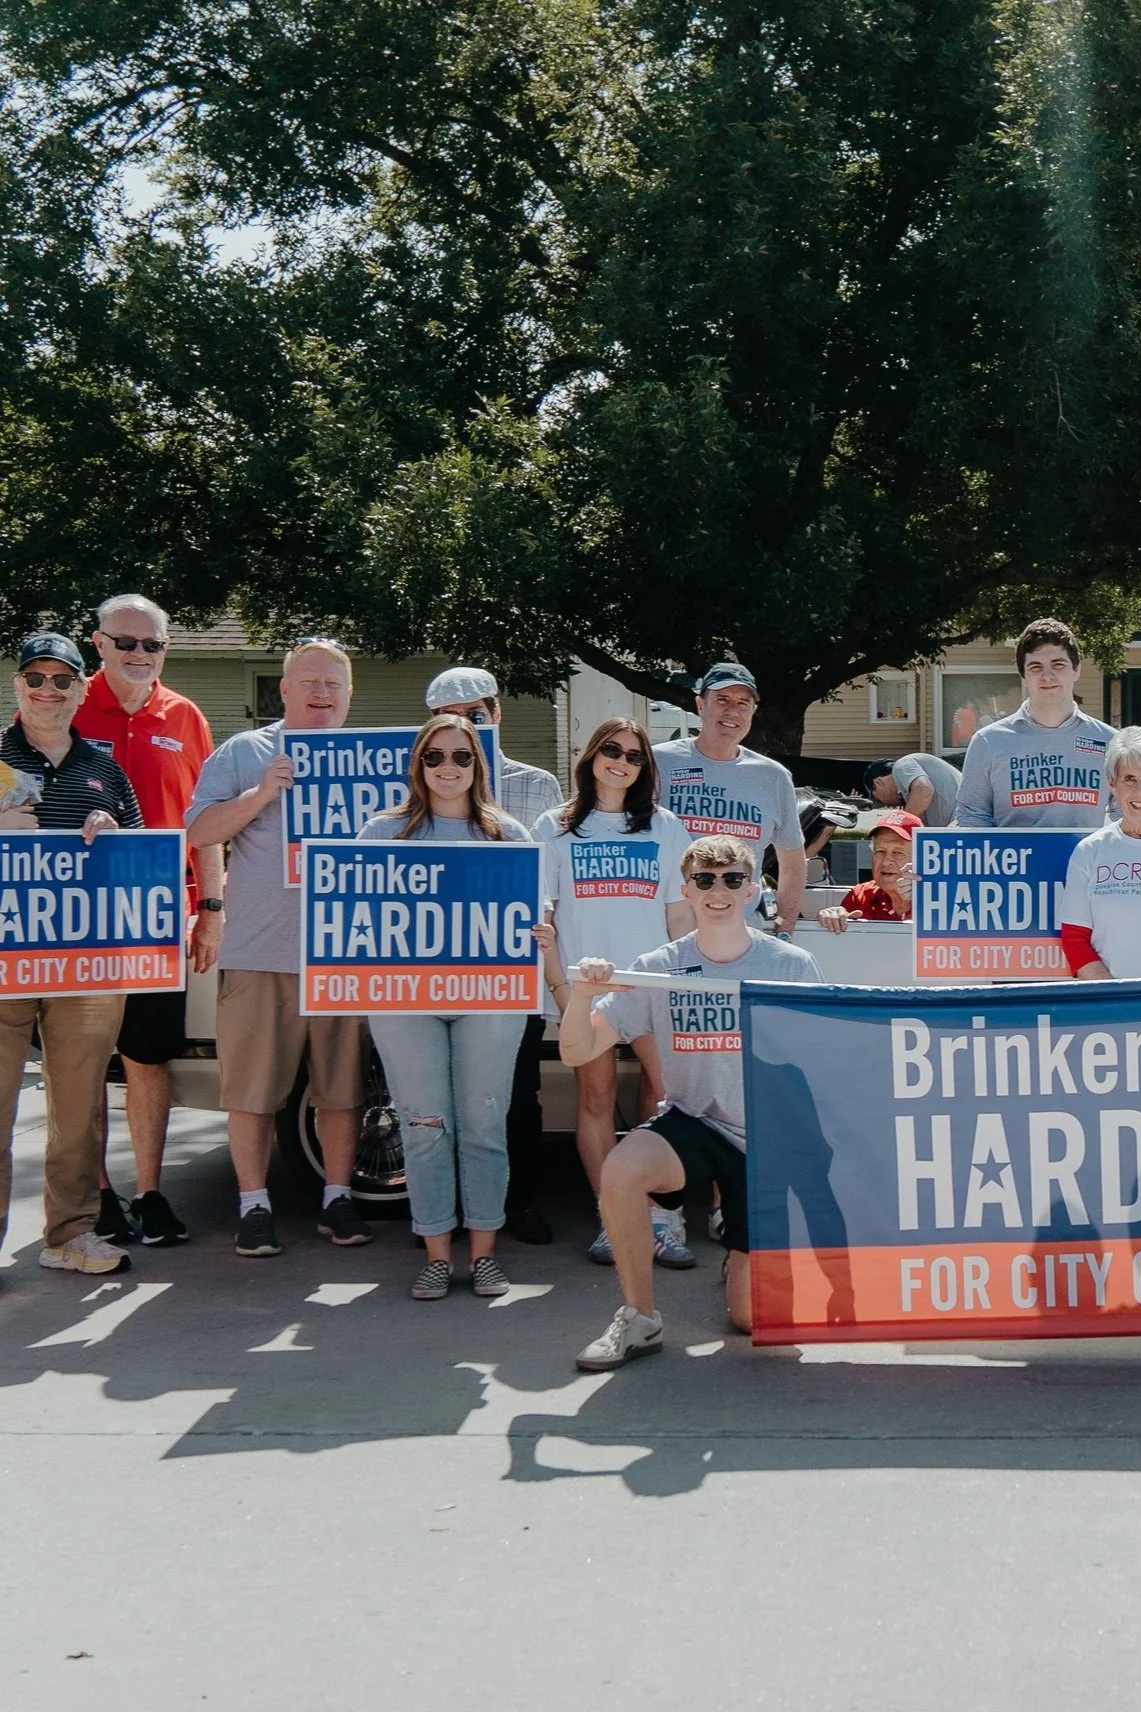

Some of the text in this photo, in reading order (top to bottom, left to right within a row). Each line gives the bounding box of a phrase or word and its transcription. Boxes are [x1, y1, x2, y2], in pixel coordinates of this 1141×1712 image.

[291, 741, 408, 777] Brinker
[1010, 753, 1063, 769] Brinker
[670, 783, 727, 797] Brinker
[1011, 767, 1100, 790] HARDING
[292, 781, 411, 835] HARD
[669, 795, 762, 824] HARDING
[1013, 790, 1097, 804] FOR CITY COUNCIL
[691, 820, 715, 832] CITY
[716, 822, 759, 838] COUNCIL
[1, 843, 90, 881] inker
[573, 844, 627, 857] Brinker
[923, 840, 1032, 875] Brinker
[313, 854, 445, 894] Brinker
[574, 857, 659, 881] HARDING
[576, 884, 596, 896] FOR
[598, 883, 620, 894] CITY
[0, 885, 174, 943] ARDING
[923, 881, 1066, 931] HARDI
[313, 901, 532, 958] HARDING
[17, 957, 68, 985] CITY
[76, 954, 173, 983] COUNCIL
[923, 945, 961, 969] FOR
[969, 945, 1013, 969] CITY
[313, 974, 530, 1001] FOR CITY COUNCIL
[669, 990, 734, 1007] Brinker
[670, 1007, 741, 1032] HARD
[675, 1036, 694, 1050] FOR
[696, 1037, 724, 1050] CITY
[900, 1256, 992, 1313] FOR
[1010, 1252, 1113, 1309] CITY
